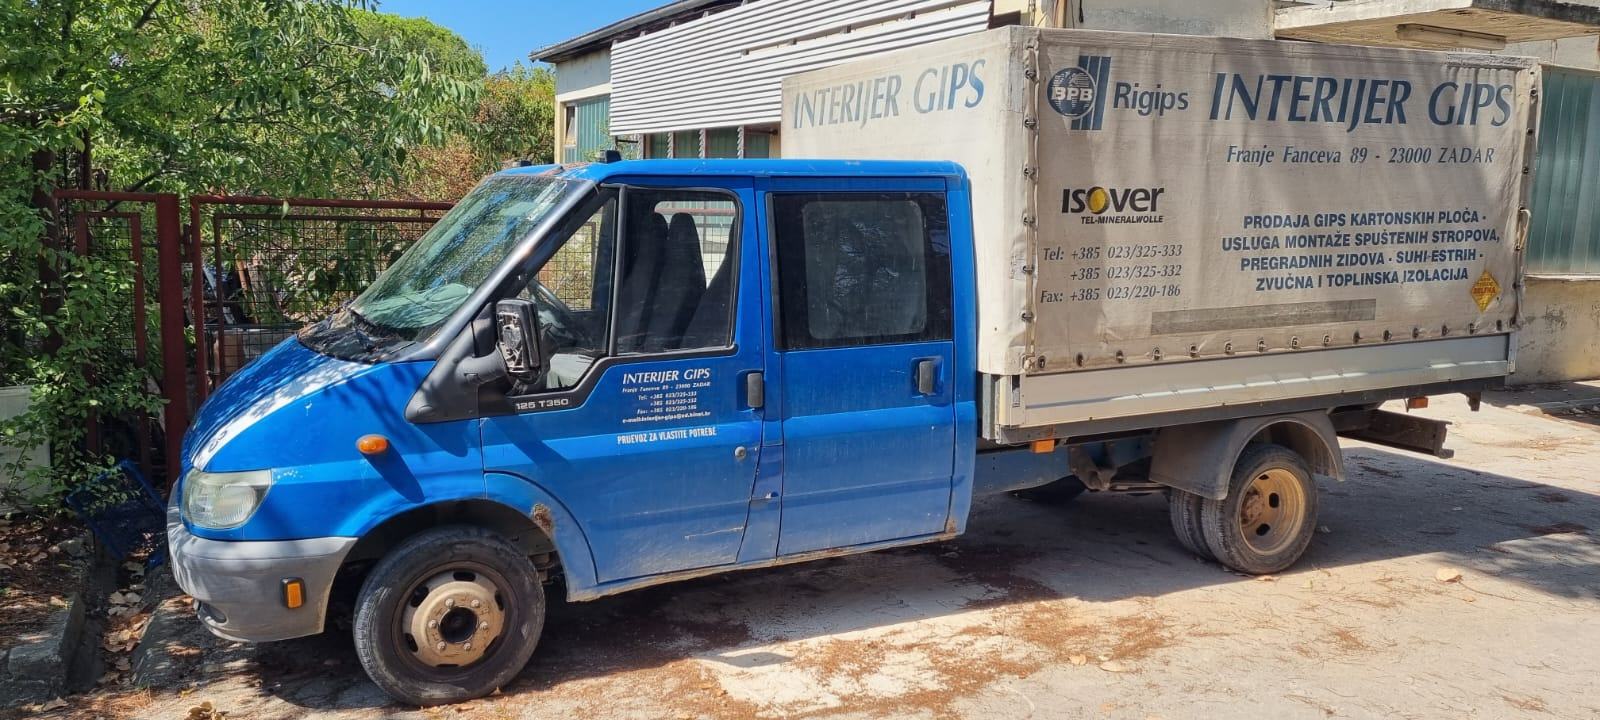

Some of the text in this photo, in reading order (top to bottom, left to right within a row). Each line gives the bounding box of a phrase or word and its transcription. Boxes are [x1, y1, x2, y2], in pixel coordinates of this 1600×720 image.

[793, 58, 986, 130] INTERIJER GIPS
[1050, 86, 1093, 101] BPB
[1113, 81, 1189, 117] Rigips
[1208, 72, 1513, 133] INTERIJER GIPS
[1226, 144, 1275, 167] Franje
[1282, 145, 1341, 164] Fanceva
[1350, 147, 1368, 164] 89
[1387, 147, 1432, 164] 23000
[1437, 147, 1495, 164] ZADAR
[1081, 215, 1164, 225] TEL-MINERALWOLLE
[1243, 207, 1479, 229] PRODAJA GIPS KARTONSKIH PLOČA
[1222, 228, 1500, 251] USLUGA MONTAŽE SPUŠTENIH STROPOVA,
[1043, 244, 1183, 261] Tel: +385 023/325-333
[1240, 254, 1333, 271] PREGRADNIH
[1336, 252, 1384, 267] ZIDOVA
[1070, 264, 1182, 281] +385 023/325-332
[1255, 272, 1314, 291] ZVUČNA
[1318, 275, 1322, 288] I
[1326, 270, 1399, 287] TOPLINSKA
[1403, 267, 1468, 283] IZOLACIJA
[1040, 284, 1181, 303] Fax: +385 023/220-186
[622, 368, 711, 384] INTERIJER GIPS
[538, 398, 569, 408] T350
[649, 431, 658, 441] ZA
[658, 429, 687, 441] VLASTITE
[689, 426, 717, 438] POTREBE
